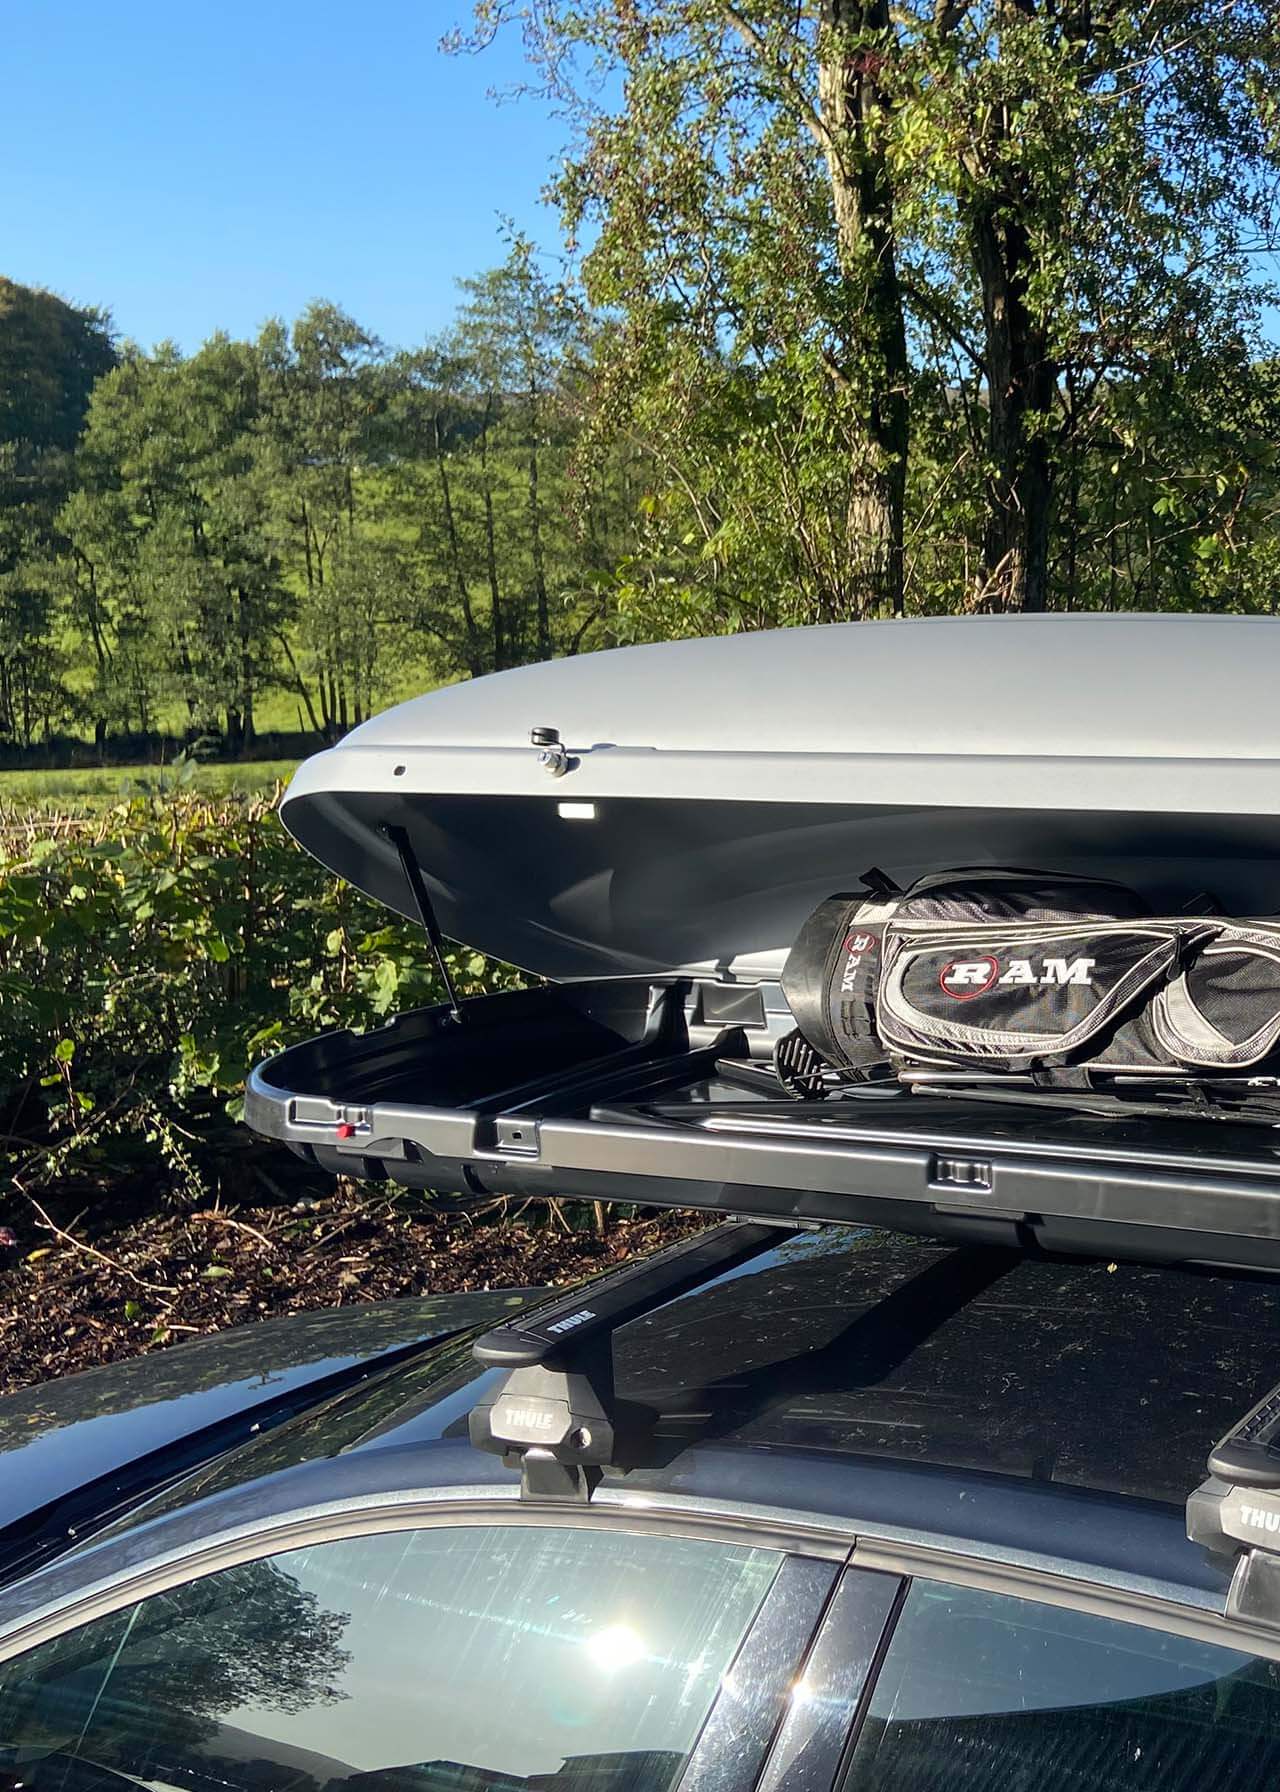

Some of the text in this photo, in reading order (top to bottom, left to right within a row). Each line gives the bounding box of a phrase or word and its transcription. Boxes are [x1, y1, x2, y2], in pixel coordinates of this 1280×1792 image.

[944, 958, 1095, 985] RAM
[547, 1310, 596, 1333] THULE
[505, 1409, 554, 1429] THULE
